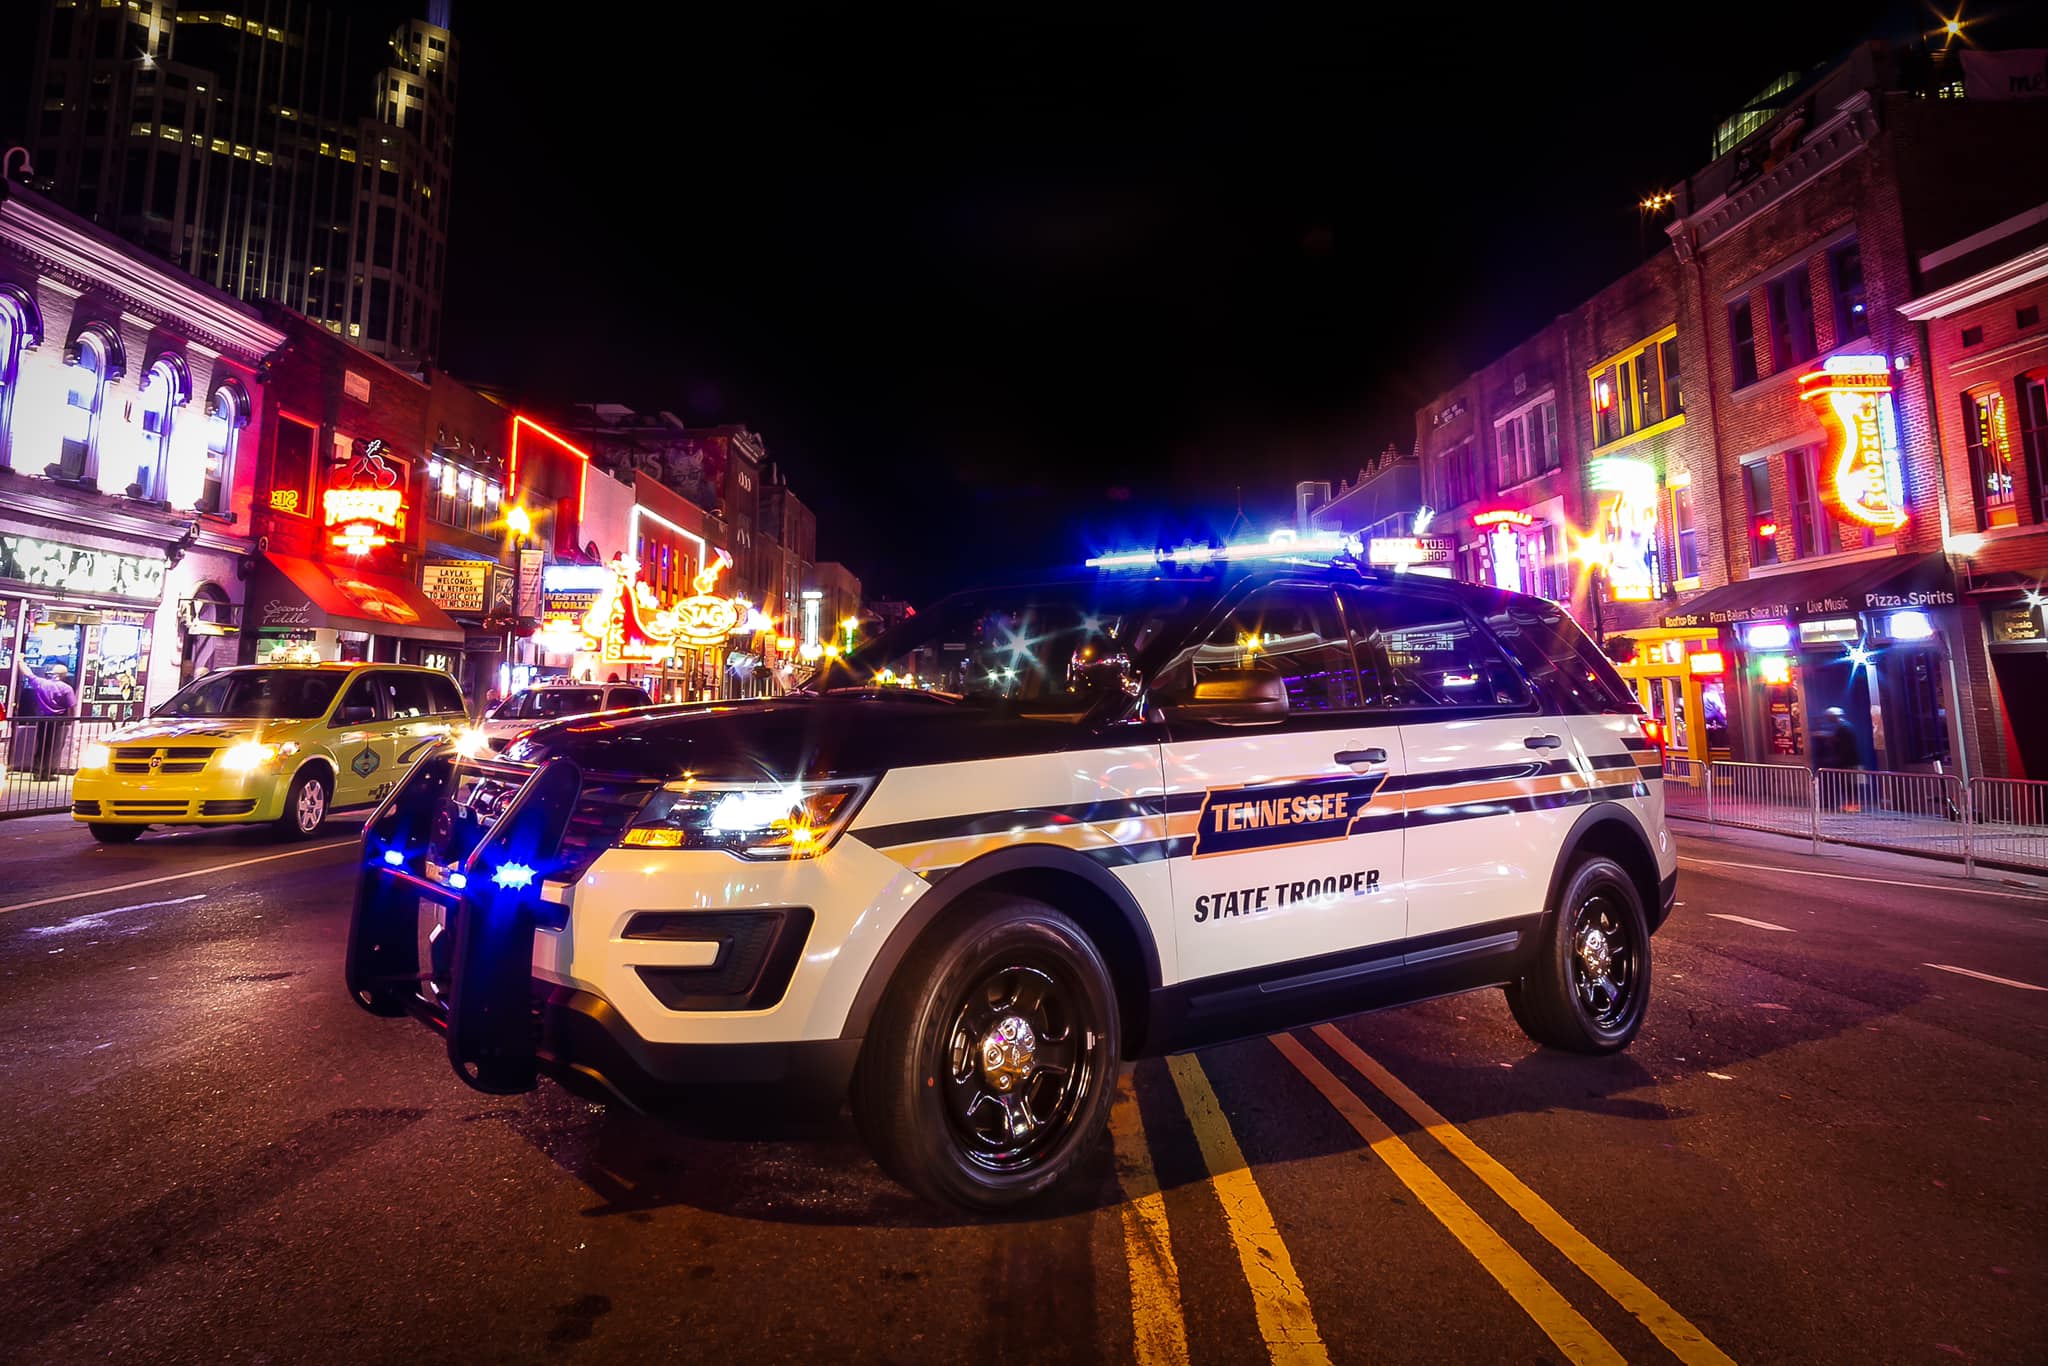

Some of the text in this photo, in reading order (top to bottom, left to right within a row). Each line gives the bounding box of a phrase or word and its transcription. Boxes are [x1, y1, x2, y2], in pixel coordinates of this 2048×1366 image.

[1831, 374, 1889, 387] MELLOW
[1856, 393, 1889, 506] MUSHROOM
[1421, 539, 1452, 550] TUBB
[1421, 550, 1448, 561] SHOP
[440, 569, 470, 577] LAYLA'S
[447, 585, 477, 593] NETWORK
[440, 592, 462, 600] MUSIC
[464, 593, 480, 601] CITY
[1865, 590, 1955, 607] Pizza Spirits
[264, 600, 310, 614] Second
[461, 600, 482, 609] DRAFT
[551, 602, 593, 610] WORLD
[544, 611, 578, 620] HOME
[1665, 597, 1848, 627] Rooftop Bar Pizza Bakers Since 1974 Live Music
[263, 612, 310, 624] Fiddle
[1211, 792, 1349, 833] TENNESSEE
[1194, 869, 1380, 923] STATE TROOPER
